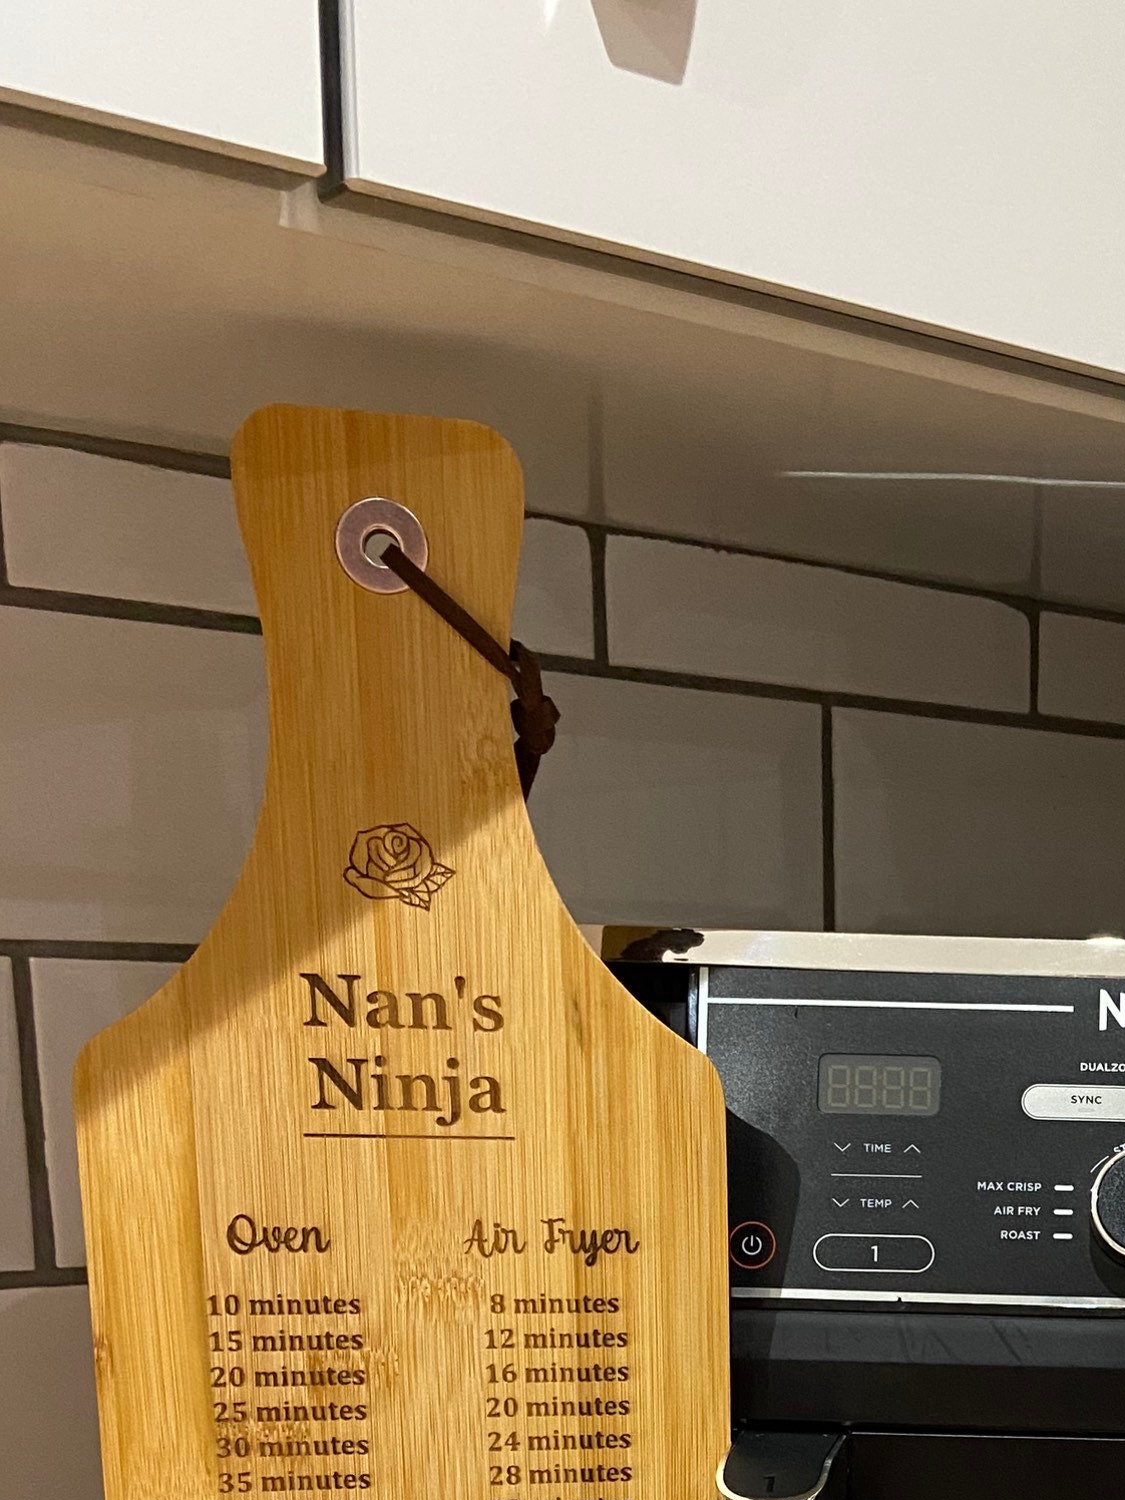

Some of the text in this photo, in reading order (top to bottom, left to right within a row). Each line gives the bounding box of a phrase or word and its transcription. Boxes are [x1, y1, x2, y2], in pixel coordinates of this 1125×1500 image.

[300, 973, 505, 1032] Nan's
[308, 1056, 506, 1126] Ninja
[1071, 1095, 1102, 1105] SYNC
[864, 1143, 891, 1154] TIME
[977, 1181, 1042, 1192] MAX CRISP
[860, 1199, 892, 1209] TEMP
[994, 1206, 1041, 1216] AIR FRY
[226, 1214, 331, 1255] Oven
[463, 1218, 639, 1266] Air Fryer
[1000, 1230, 1040, 1240] ROAST
[870, 1245, 880, 1262] 1
[207, 1293, 361, 1316] 10 minutes
[490, 1293, 620, 1314] 8 minutes
[209, 1329, 363, 1352] 15 minutes
[484, 1328, 629, 1349] 12 minutes
[211, 1366, 366, 1388] 20 minutes
[486, 1363, 630, 1383] 16 minutes
[214, 1401, 368, 1423] 25 minutes
[486, 1397, 630, 1417] 20 minutes
[488, 1431, 631, 1451] 24 minutes
[219, 1469, 371, 1493] 35 minutes
[490, 1464, 633, 1486] 28 minutes
